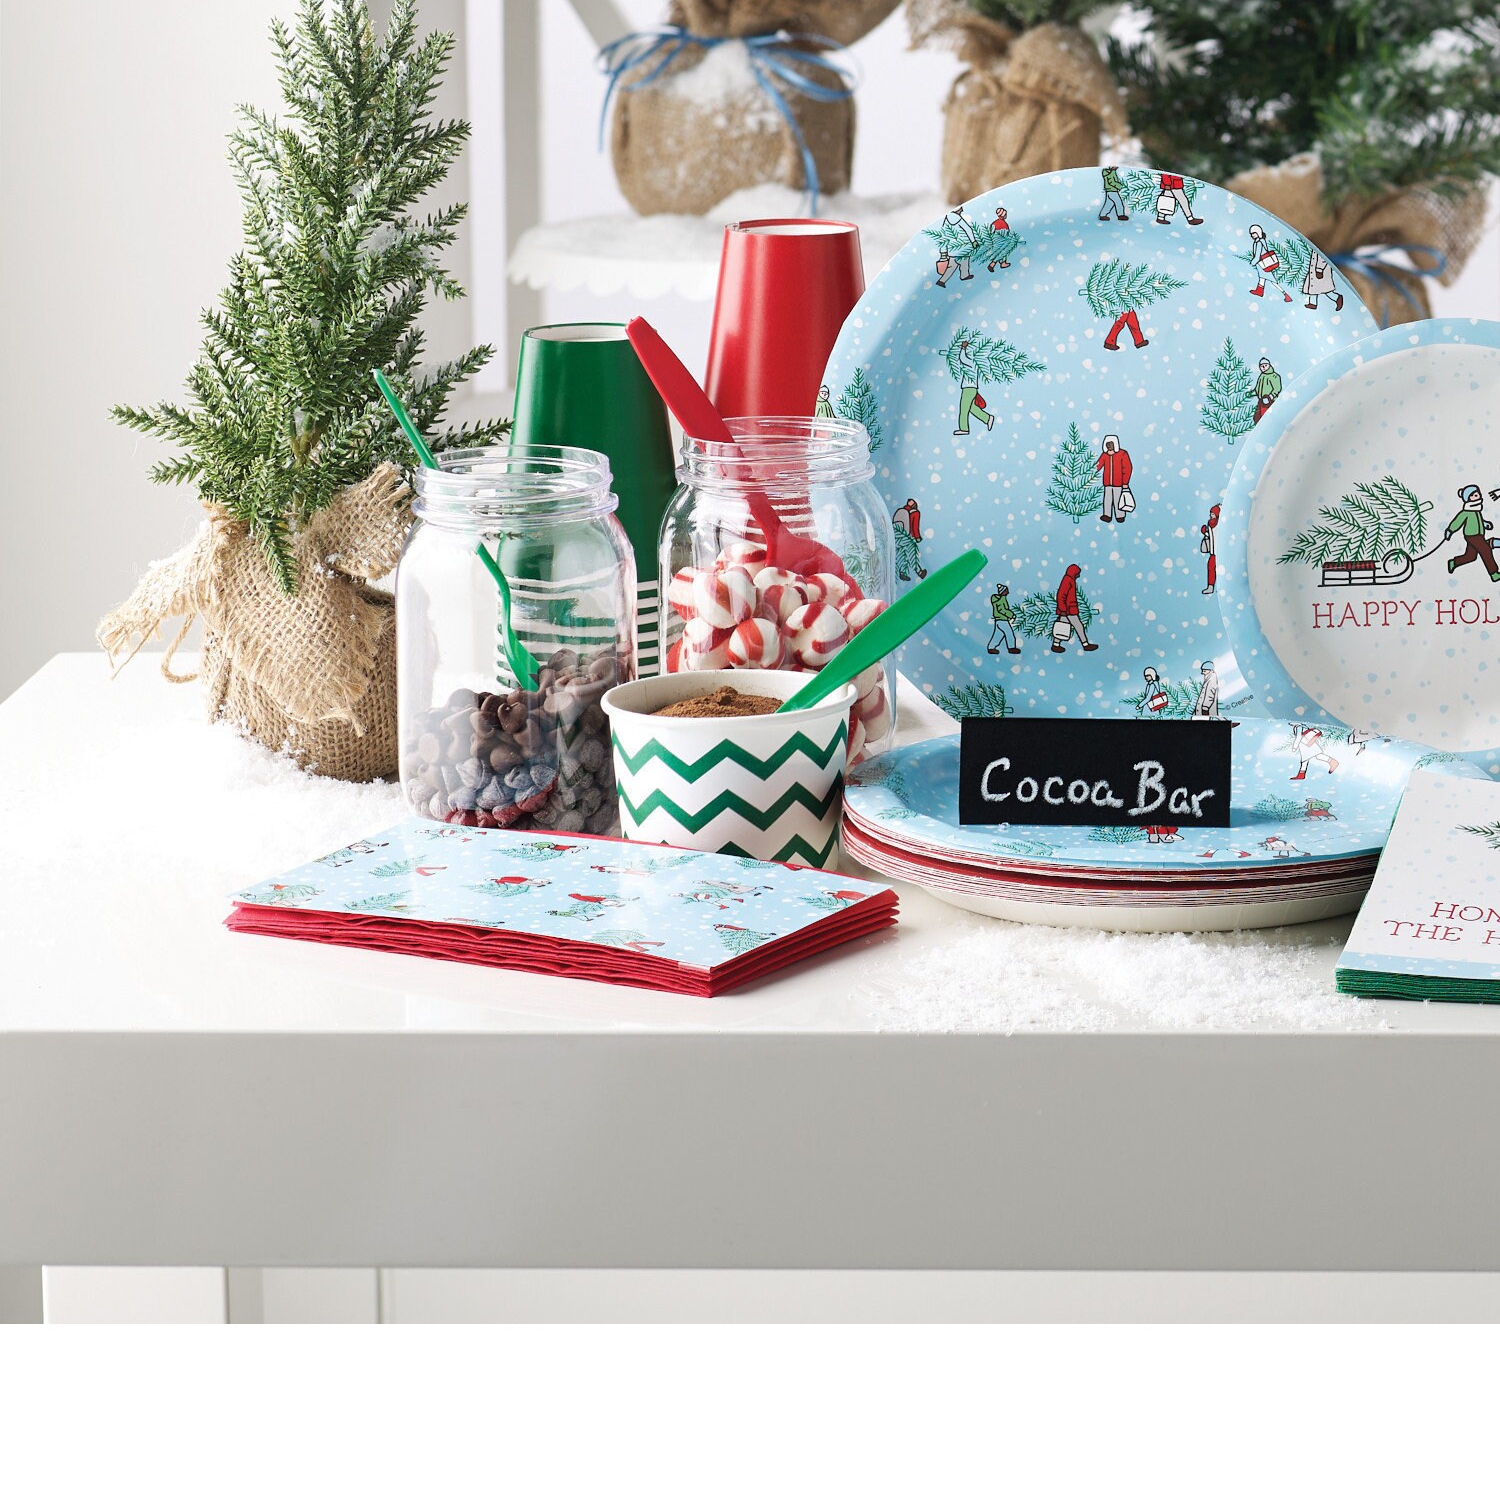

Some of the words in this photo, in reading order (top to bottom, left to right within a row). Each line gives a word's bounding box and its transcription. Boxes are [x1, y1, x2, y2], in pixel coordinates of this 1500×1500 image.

[1312, 600, 1421, 629] HAPPY
[980, 756, 1124, 809] Cocoa
[1127, 759, 1216, 818] Bar
[1383, 919, 1464, 942] THE
